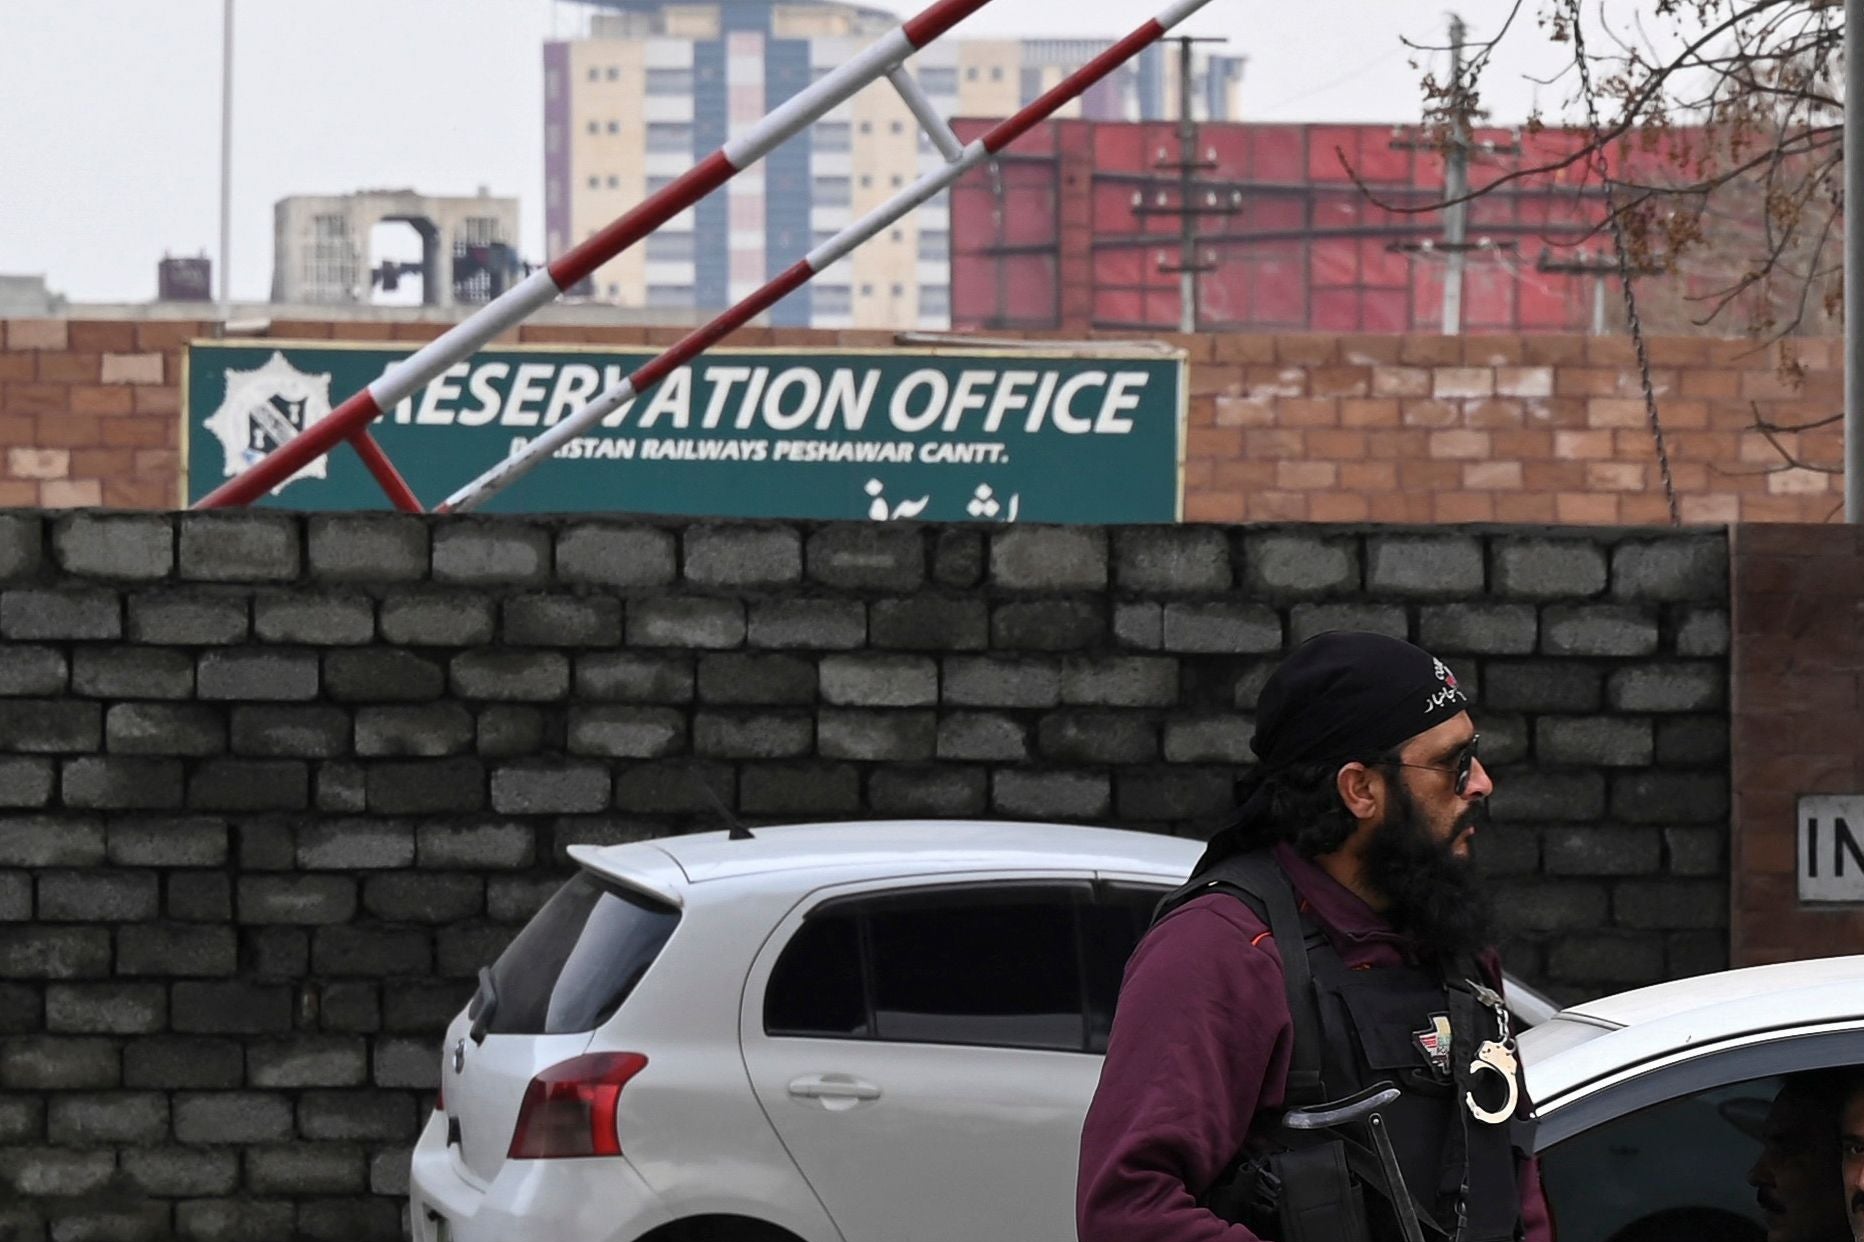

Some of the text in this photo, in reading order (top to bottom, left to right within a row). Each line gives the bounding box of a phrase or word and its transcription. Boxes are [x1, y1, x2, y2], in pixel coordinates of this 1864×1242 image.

[888, 368, 1149, 434] OFFICE
[509, 436, 1009, 463] PISTAN RAILWAYS PESHAWAR CANTT.
